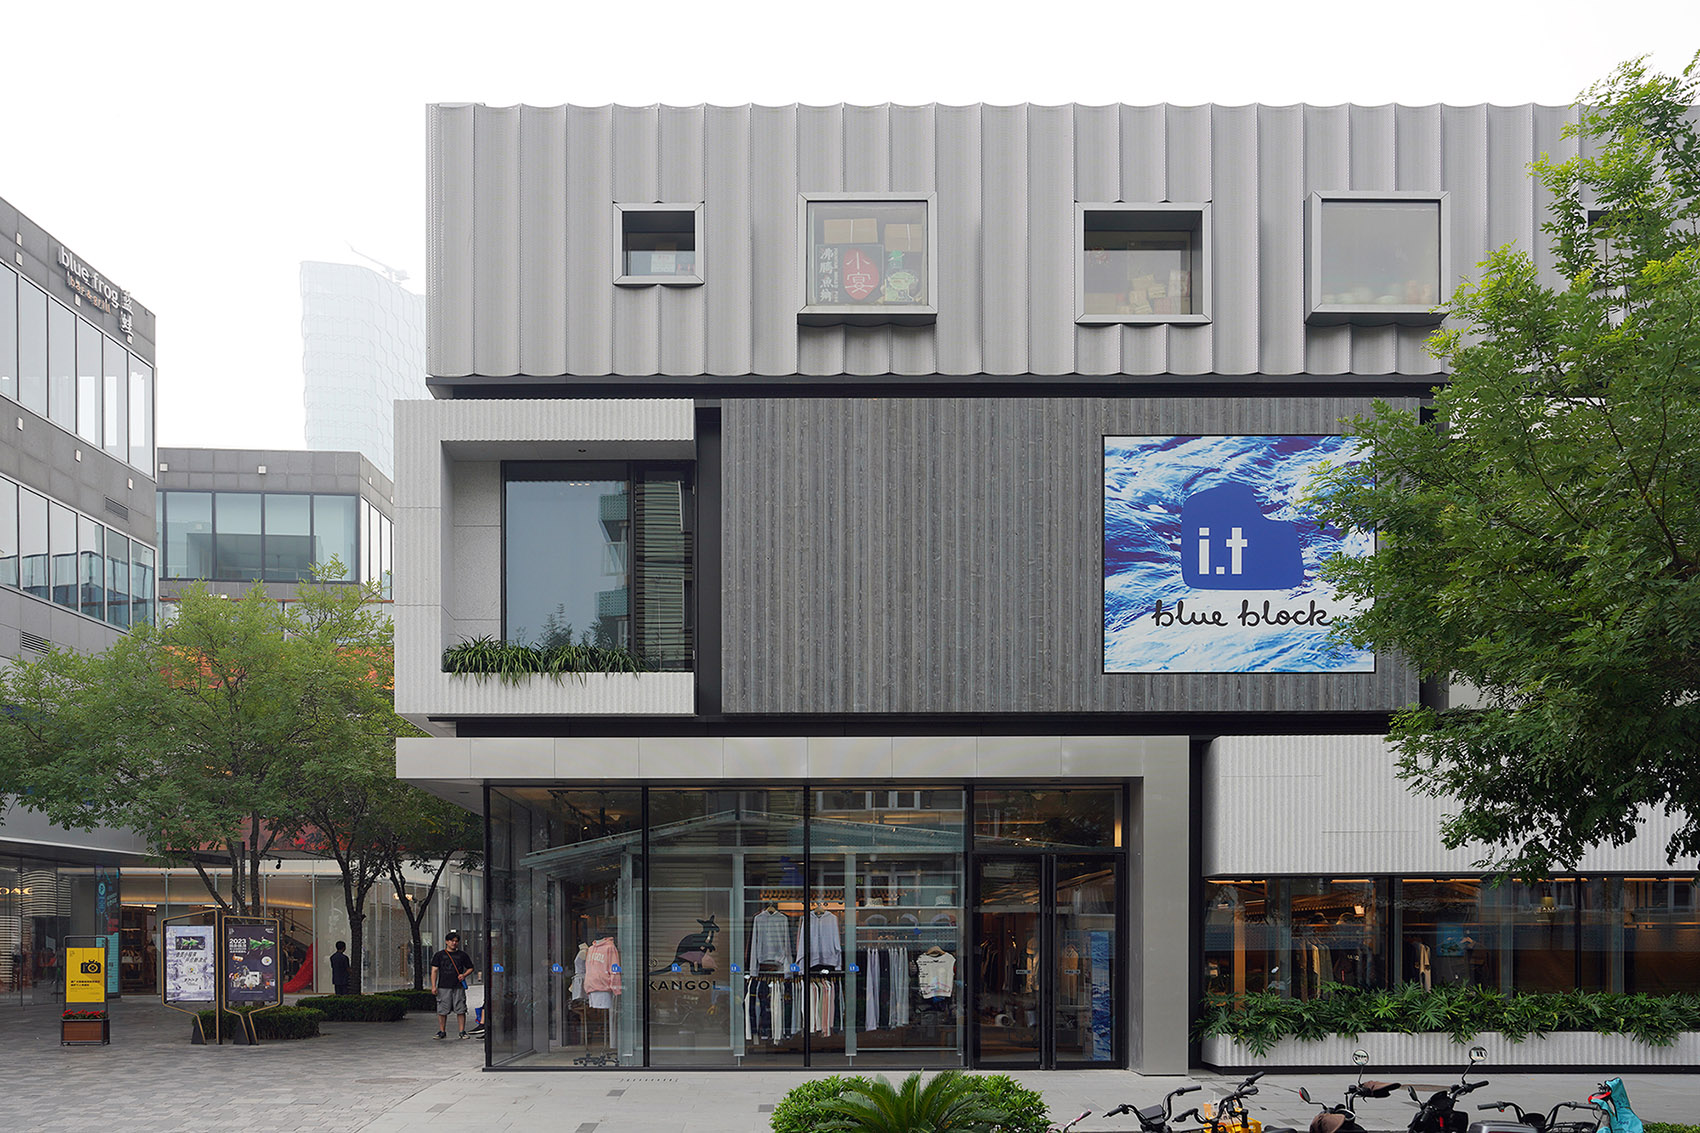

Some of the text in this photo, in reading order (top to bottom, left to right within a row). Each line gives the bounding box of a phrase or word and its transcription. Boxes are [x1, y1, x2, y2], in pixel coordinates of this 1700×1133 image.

[60, 246, 120, 309] blue frog
[1197, 527, 1248, 575] i.t
[1151, 599, 1334, 627] blue block
[648, 980, 721, 991] KANGOL
